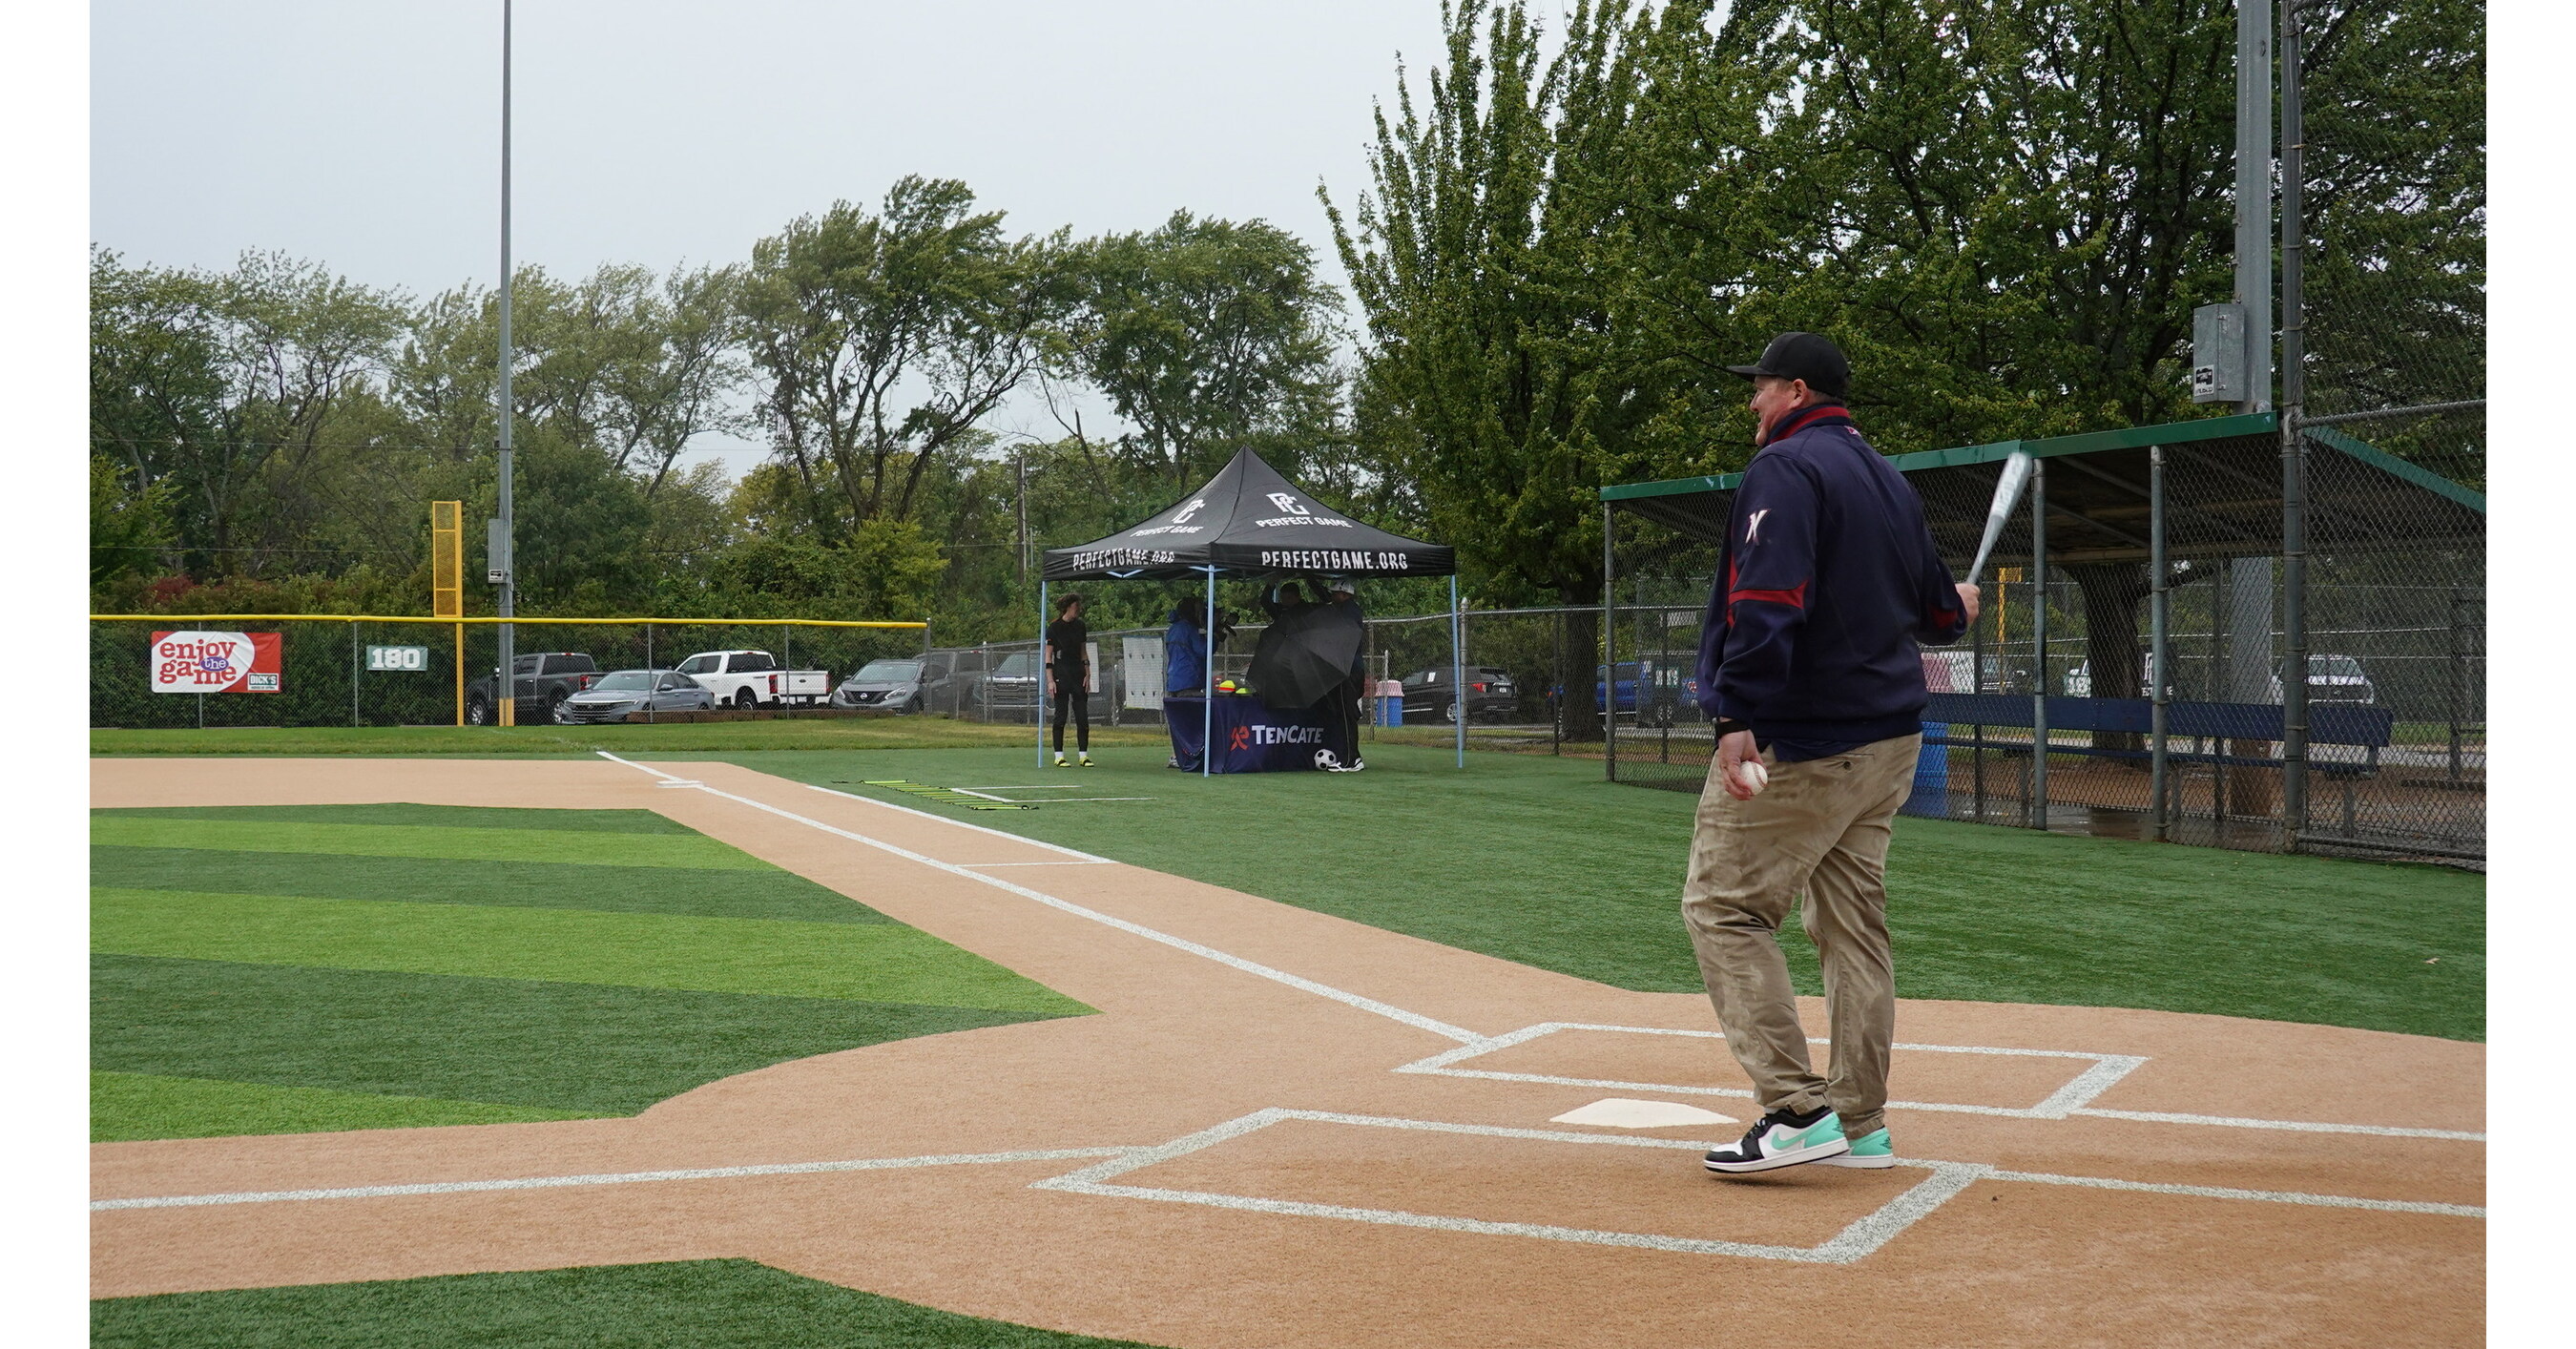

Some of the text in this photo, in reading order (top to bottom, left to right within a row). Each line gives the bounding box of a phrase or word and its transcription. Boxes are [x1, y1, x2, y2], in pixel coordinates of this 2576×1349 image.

[1256, 516, 1353, 529] PERFECT GAME
[1130, 527, 1174, 537] PERFECT
[1261, 550, 1408, 570] PERFECTGAME.ORG
[159, 638, 237, 666] enjoy
[372, 648, 421, 669] 180
[159, 659, 237, 684] game
[204, 658, 226, 670] the
[250, 674, 277, 685] DICK'S
